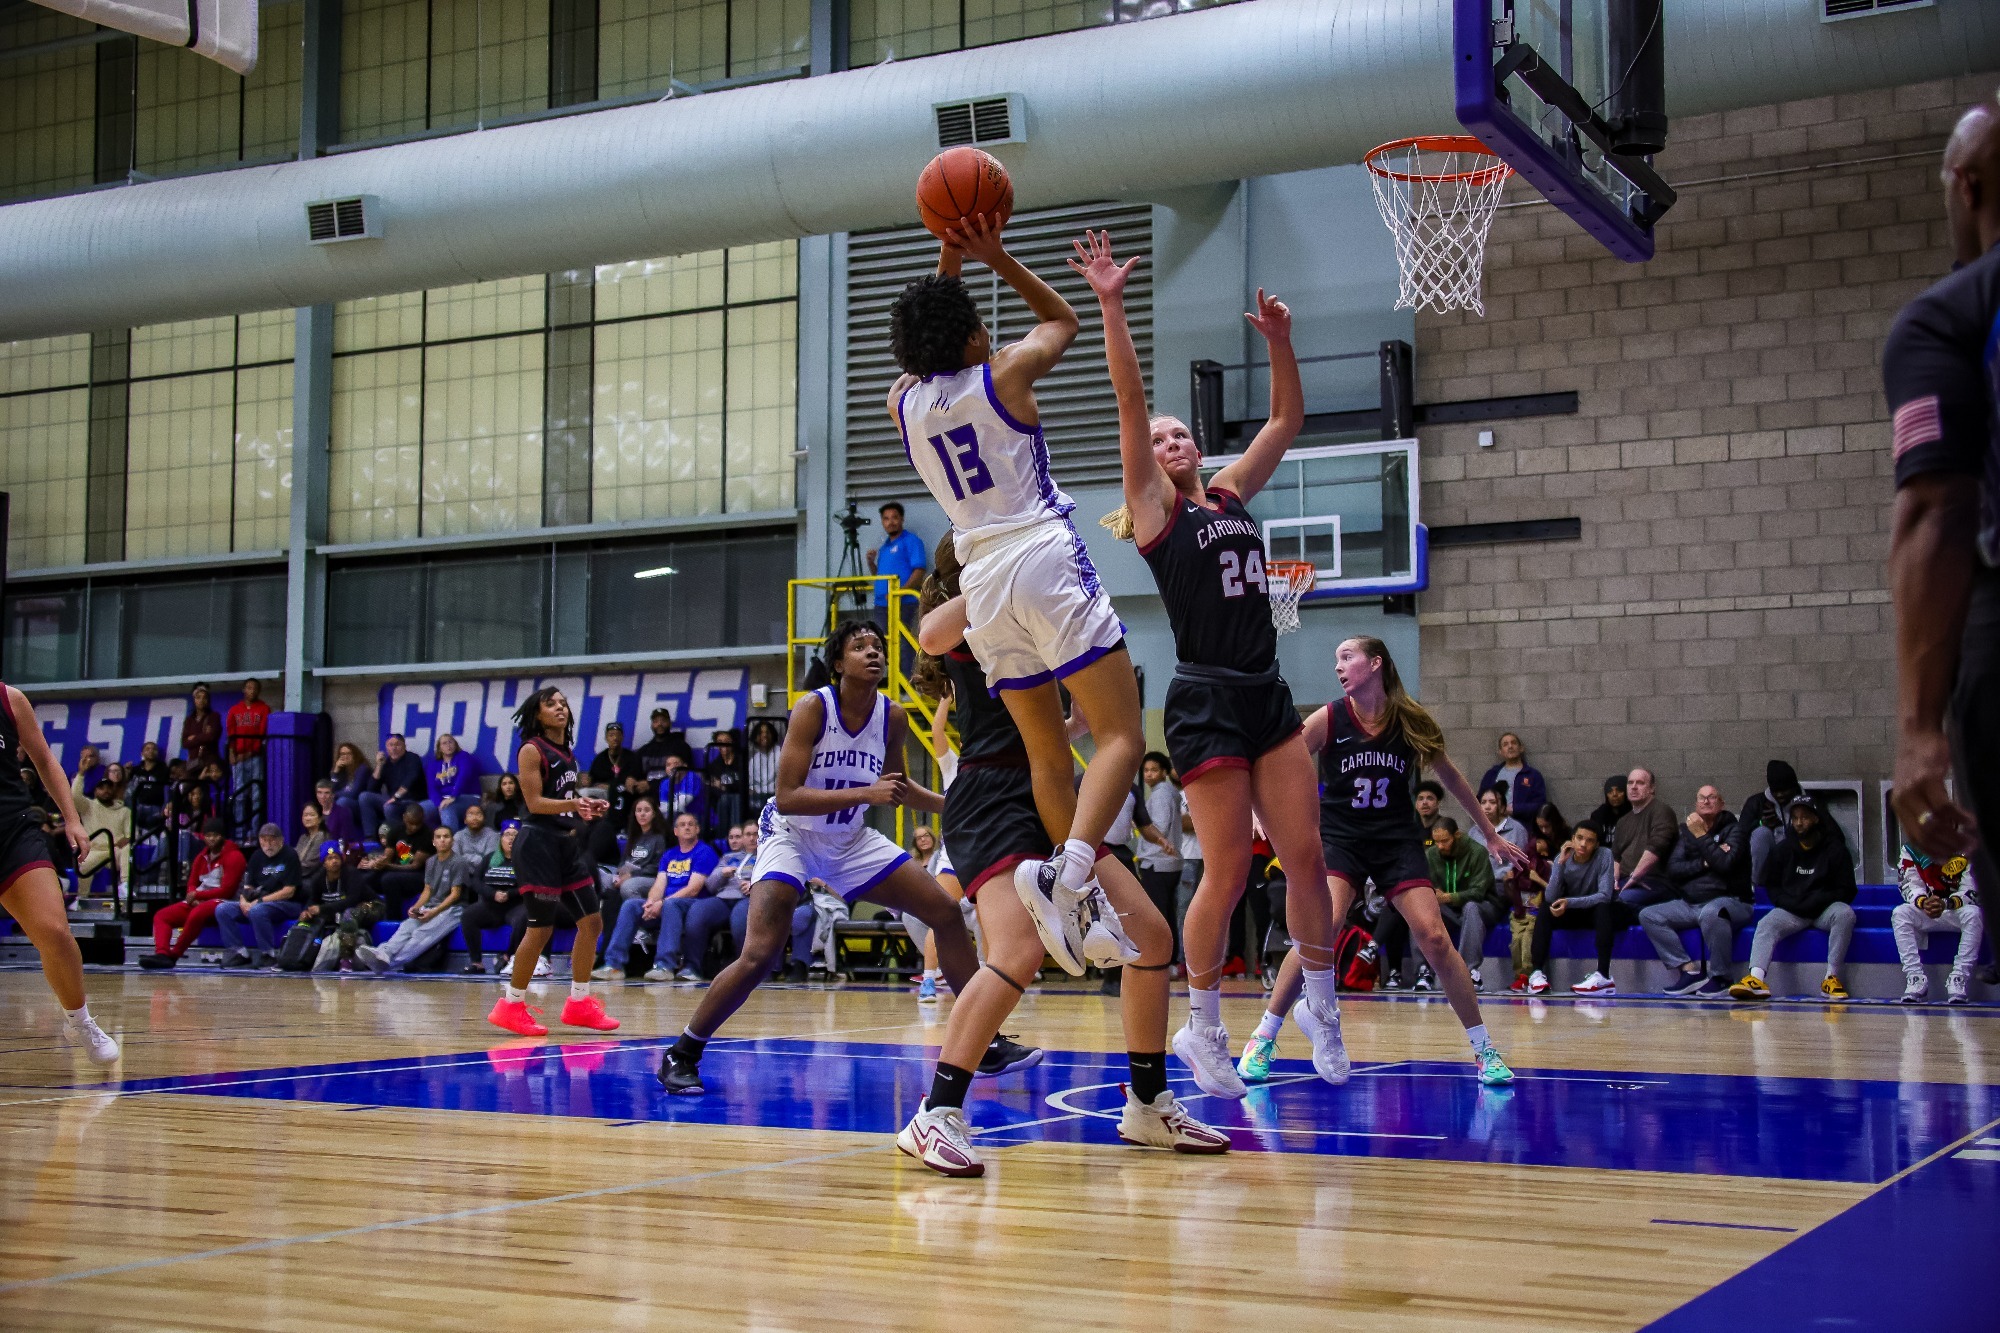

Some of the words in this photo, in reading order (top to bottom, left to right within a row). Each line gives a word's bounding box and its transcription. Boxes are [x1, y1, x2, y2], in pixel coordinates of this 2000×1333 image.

[928, 421, 995, 501] 13
[1196, 519, 1263, 550] CARDINAL
[1219, 550, 1268, 598] 24
[389, 668, 745, 773] COYOTES
[811, 749, 883, 778] COYOTES
[1341, 751, 1405, 774] CARDINALS
[1351, 777, 1390, 809] 33
